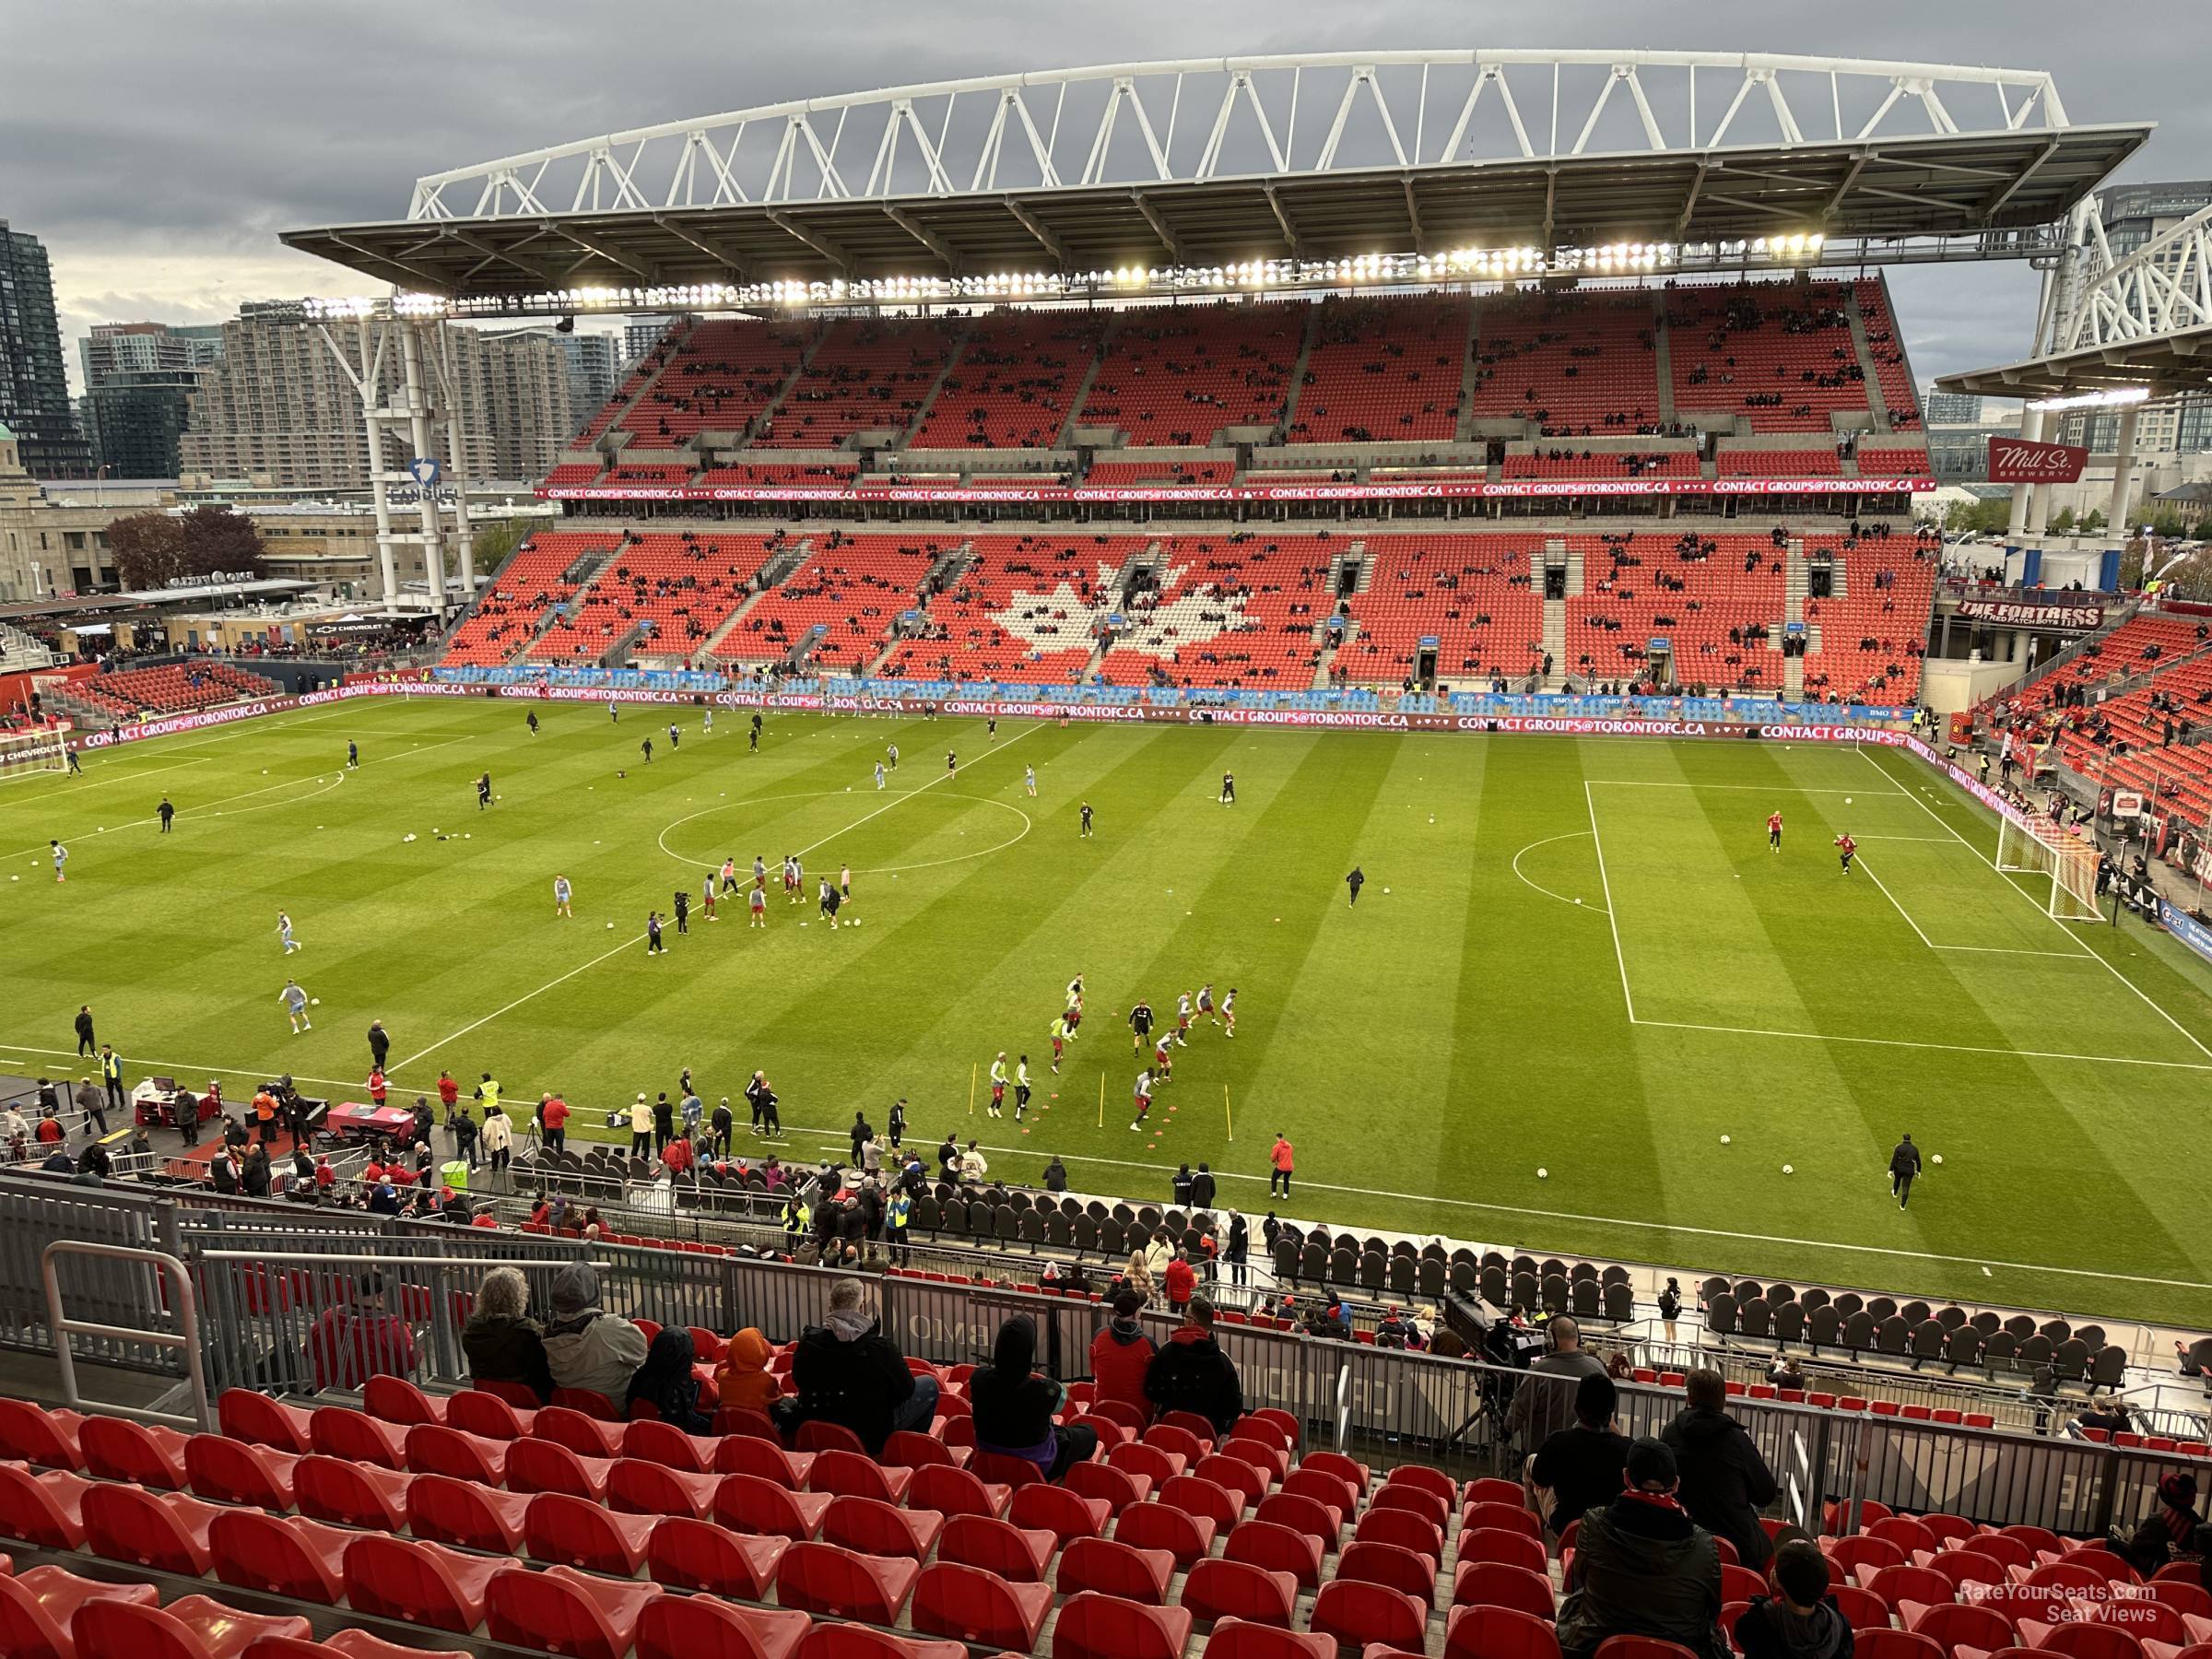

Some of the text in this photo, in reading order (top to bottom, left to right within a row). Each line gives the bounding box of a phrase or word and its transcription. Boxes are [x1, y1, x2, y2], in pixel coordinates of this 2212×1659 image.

[1995, 446, 2072, 469] Mill St.
[1482, 483, 1670, 495] CONTACT GROUPS@TORONTOFC.CA
[1712, 480, 1914, 492] CONTACT GROUPS@TORONTOFC.CA
[547, 488, 684, 499] CONTACT GROUPS@TORONTOFC.CA
[713, 489, 857, 500] CONTACT GROUPS@TORONTOFC.CA
[889, 490, 1040, 500] CONTACT GROUPS@TORONTOFC.CA
[1073, 490, 1233, 500] CONTACT GROUPS@TORONTOFC.CA
[1269, 487, 1443, 499] CONTACT GROUPS@TORONTOFC.CA
[1960, 601, 2100, 626] THE FORTRESS
[2007, 617, 2035, 625] PATCH
[338, 624, 382, 632] CHEVROLET
[299, 688, 339, 706] CONTACT
[500, 687, 677, 703] CONTAC GROUPS@TORONTOFC.CA
[944, 701, 997, 713] CONTACT
[85, 704, 267, 747] CONACT GROUPS@TORONTOFC.CA
[1248, 711, 1409, 727] GROUPS@TORONTOFC.CA
[1524, 718, 1706, 735] GROUPS@TORONTOFC.CA
[1760, 724, 1831, 738] CONTACT
[1948, 764, 1971, 792] CONTACT
[2161, 907, 2184, 930] Crest
